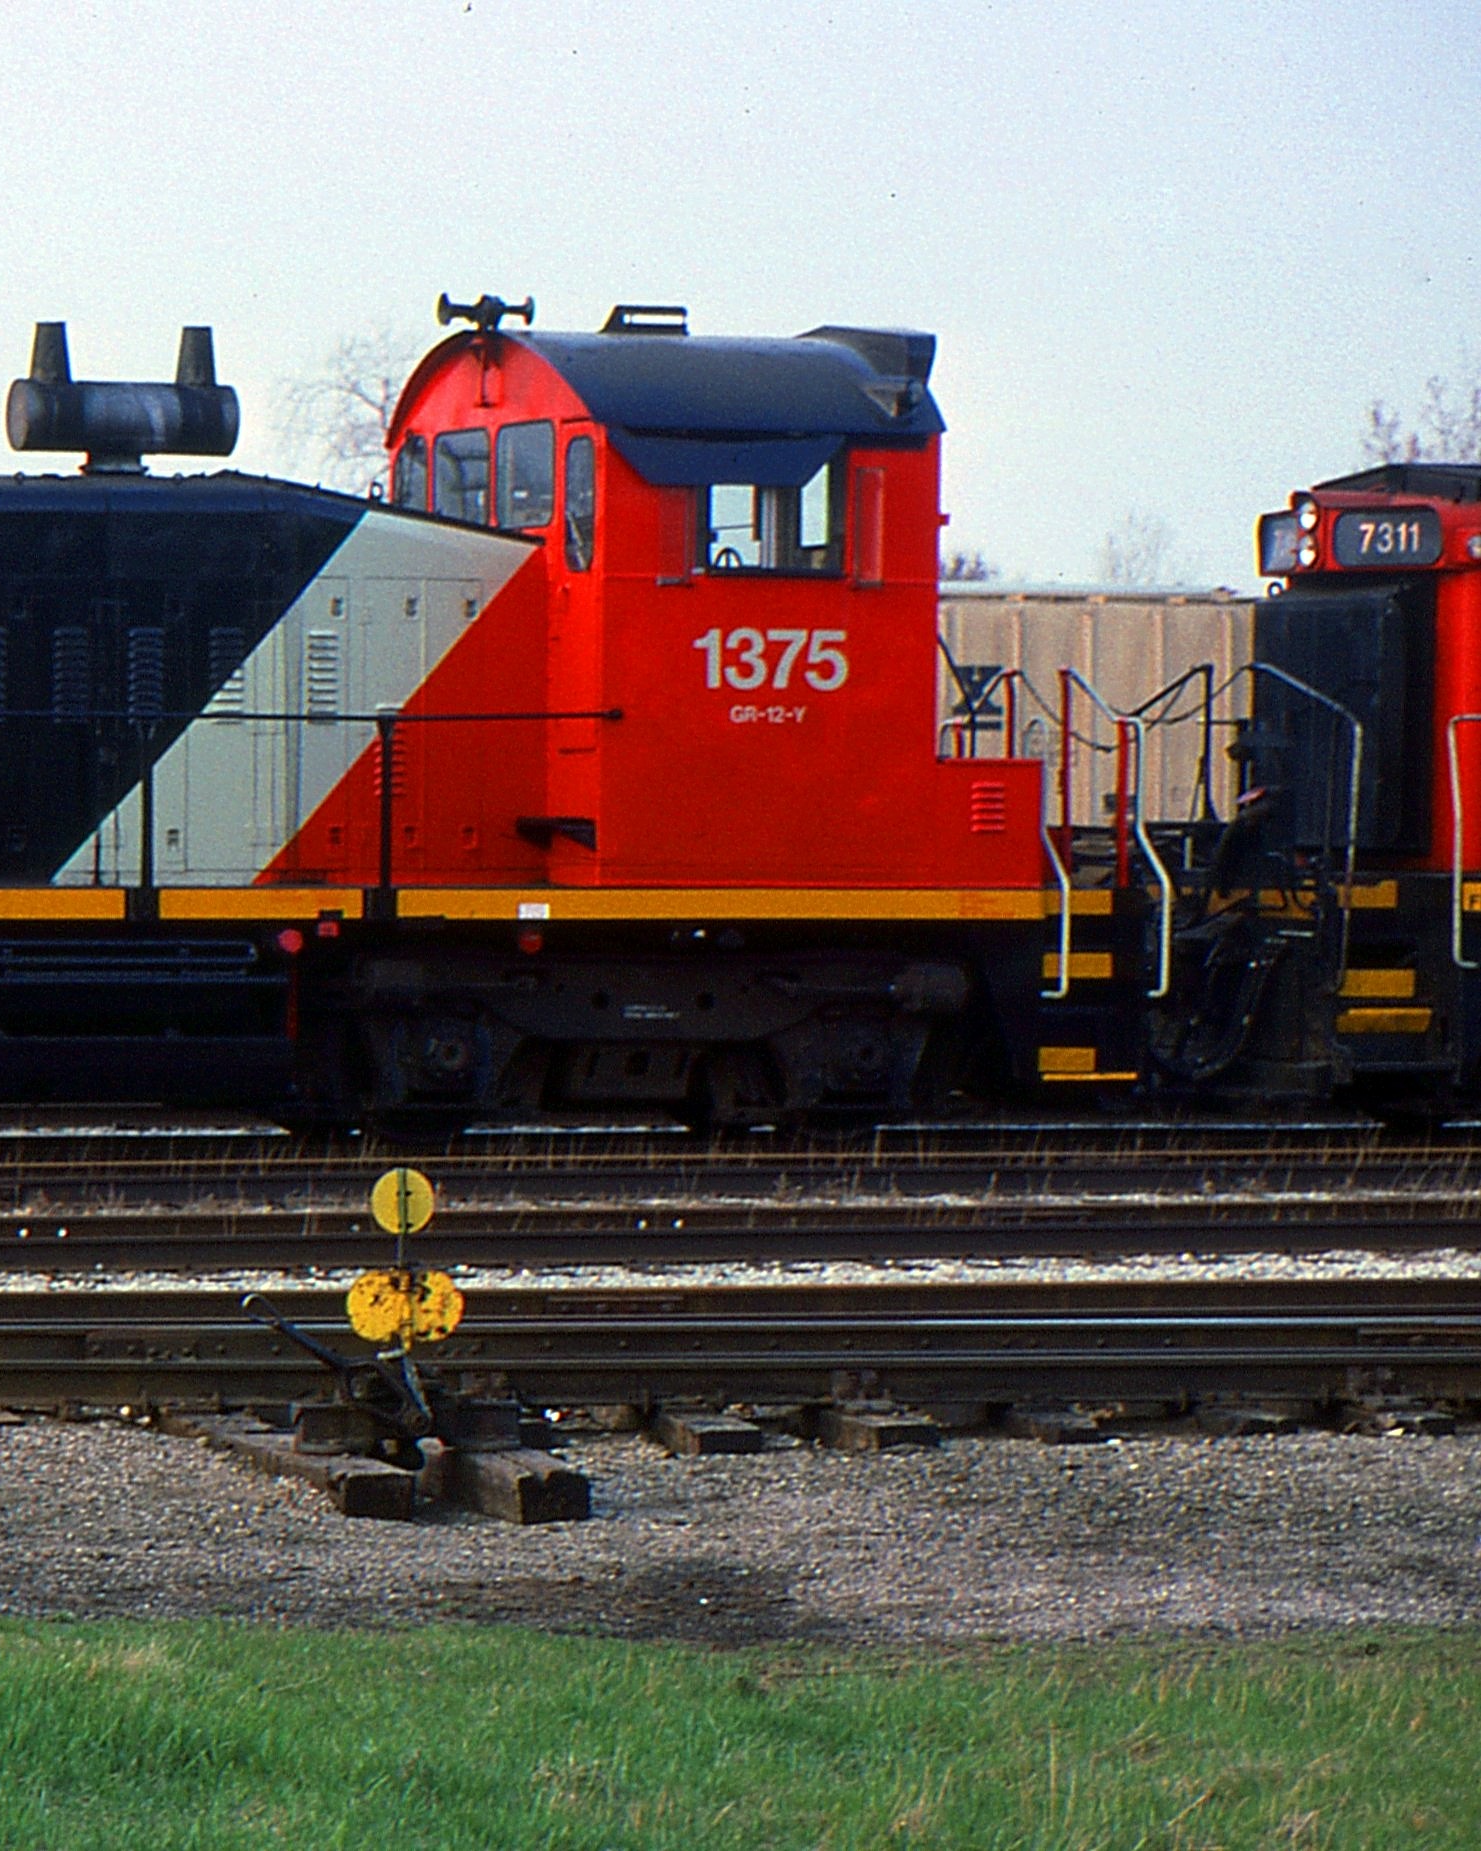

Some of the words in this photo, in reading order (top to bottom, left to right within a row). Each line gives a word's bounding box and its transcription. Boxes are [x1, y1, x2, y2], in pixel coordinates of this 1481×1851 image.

[1358, 521, 1421, 555] 7311
[692, 627, 850, 691] 1375
[728, 705, 807, 724] GR-12-Y
